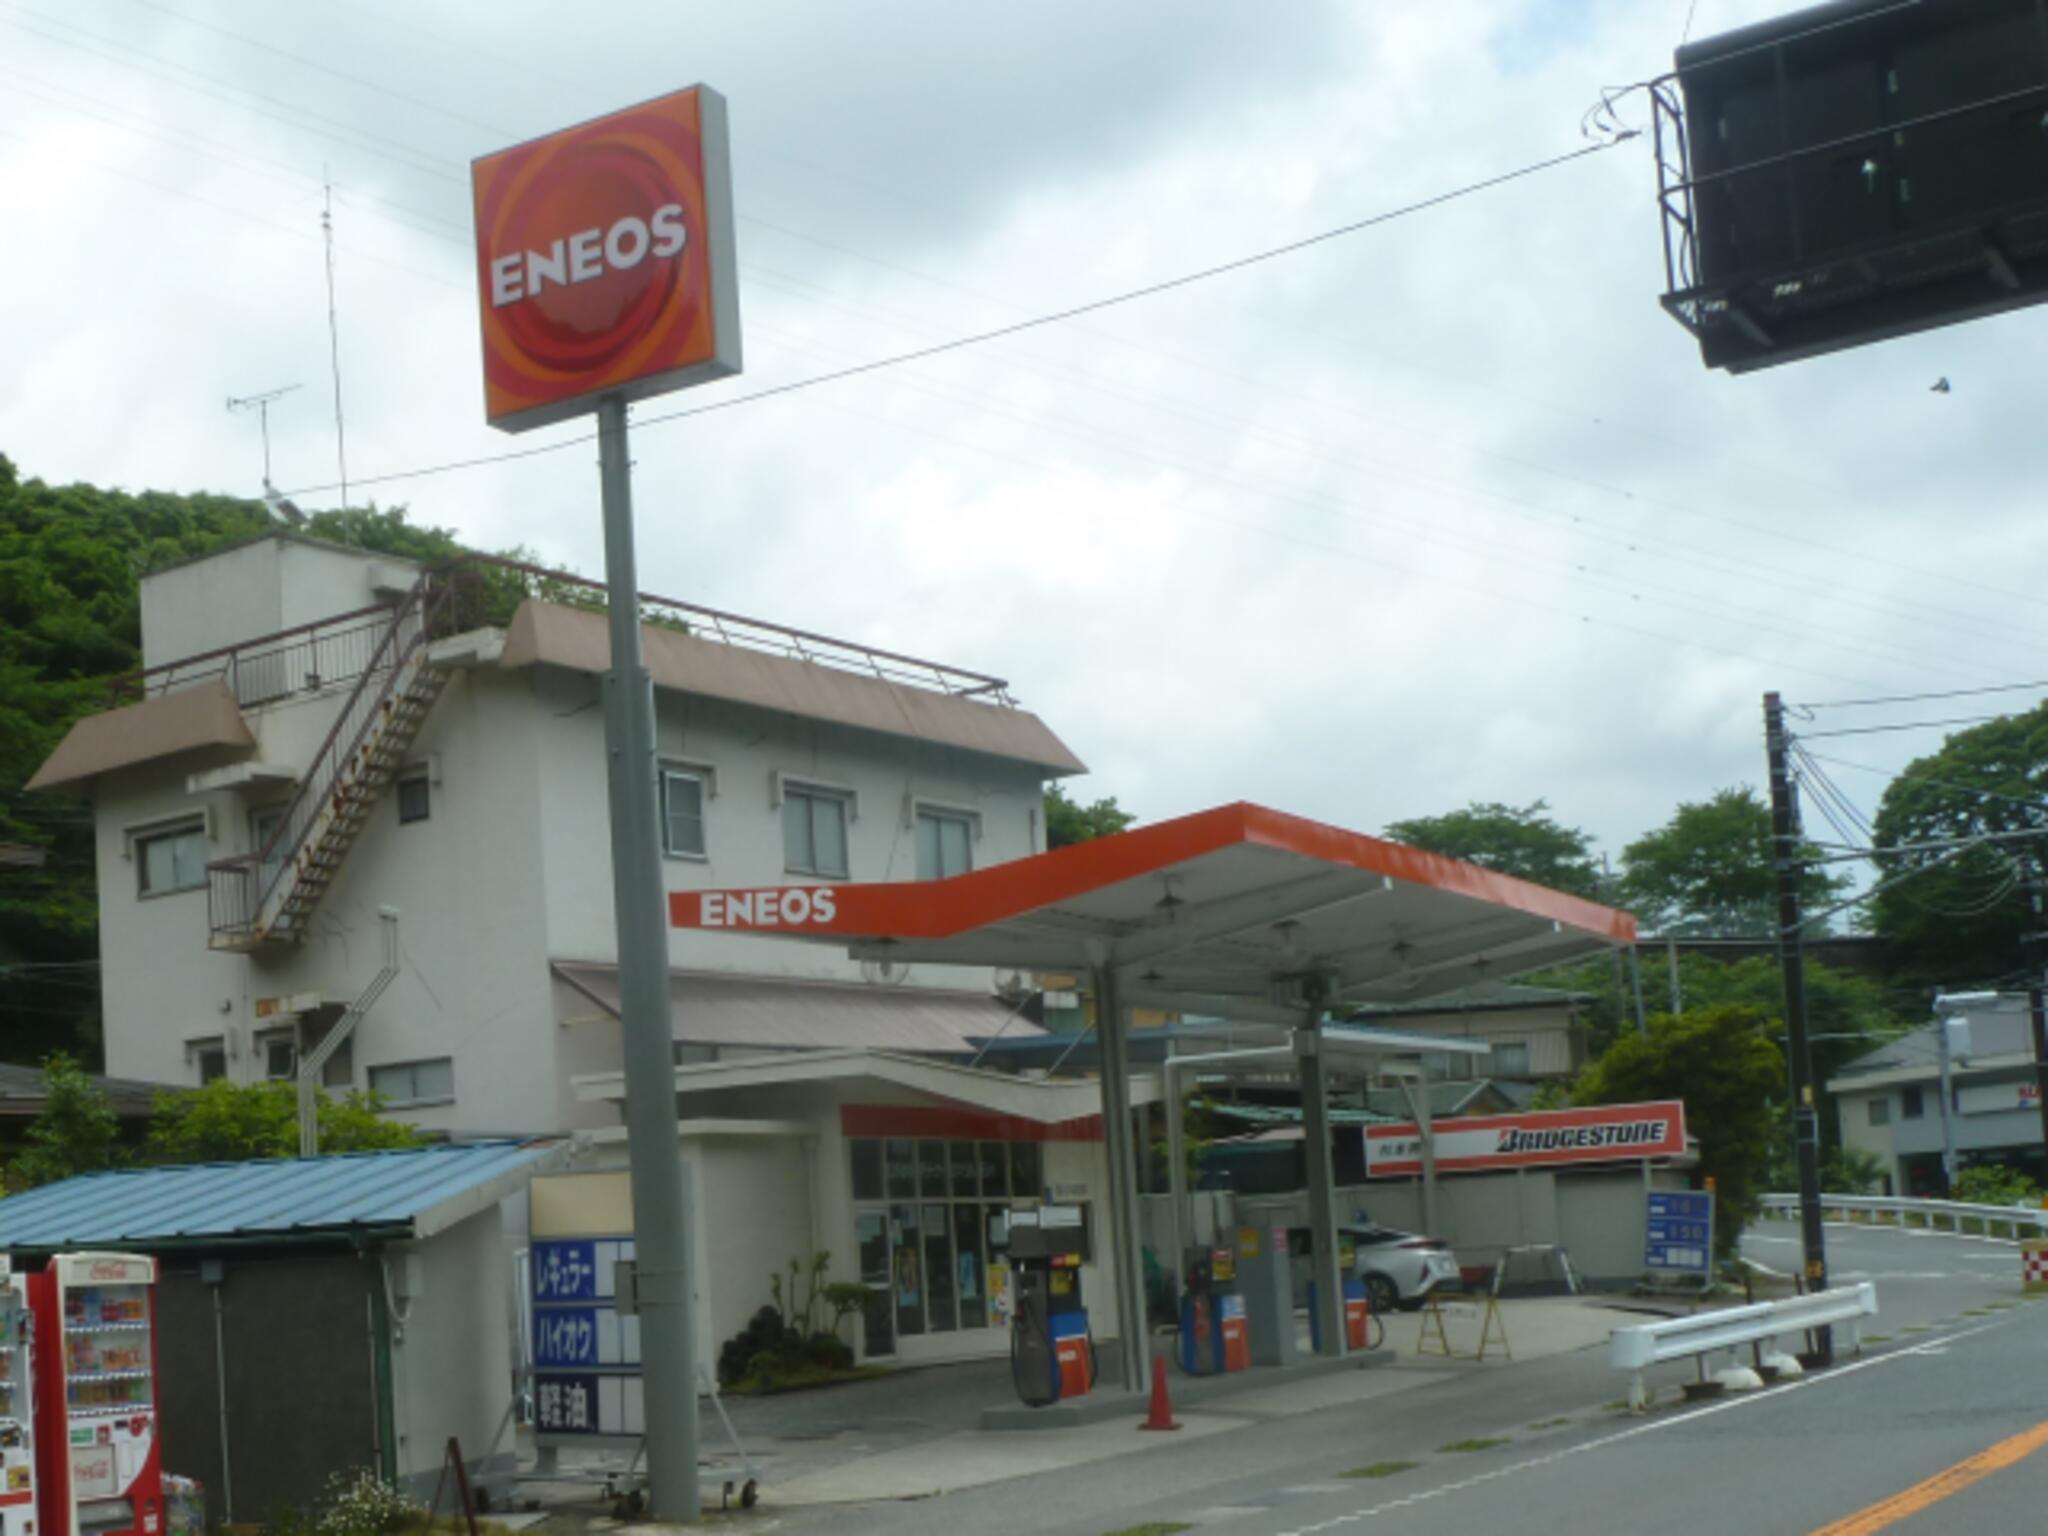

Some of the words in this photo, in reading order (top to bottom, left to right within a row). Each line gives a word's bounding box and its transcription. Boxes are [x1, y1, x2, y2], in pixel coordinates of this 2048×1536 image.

[490, 202, 687, 307] ENEOS
[699, 887, 836, 927] ENEOS
[1497, 1121, 1665, 1153] BRIDGESTONE
[536, 1247, 590, 1295] レギュラー
[538, 1316, 592, 1360] ハイオク
[538, 1382, 589, 1428] 軽油
